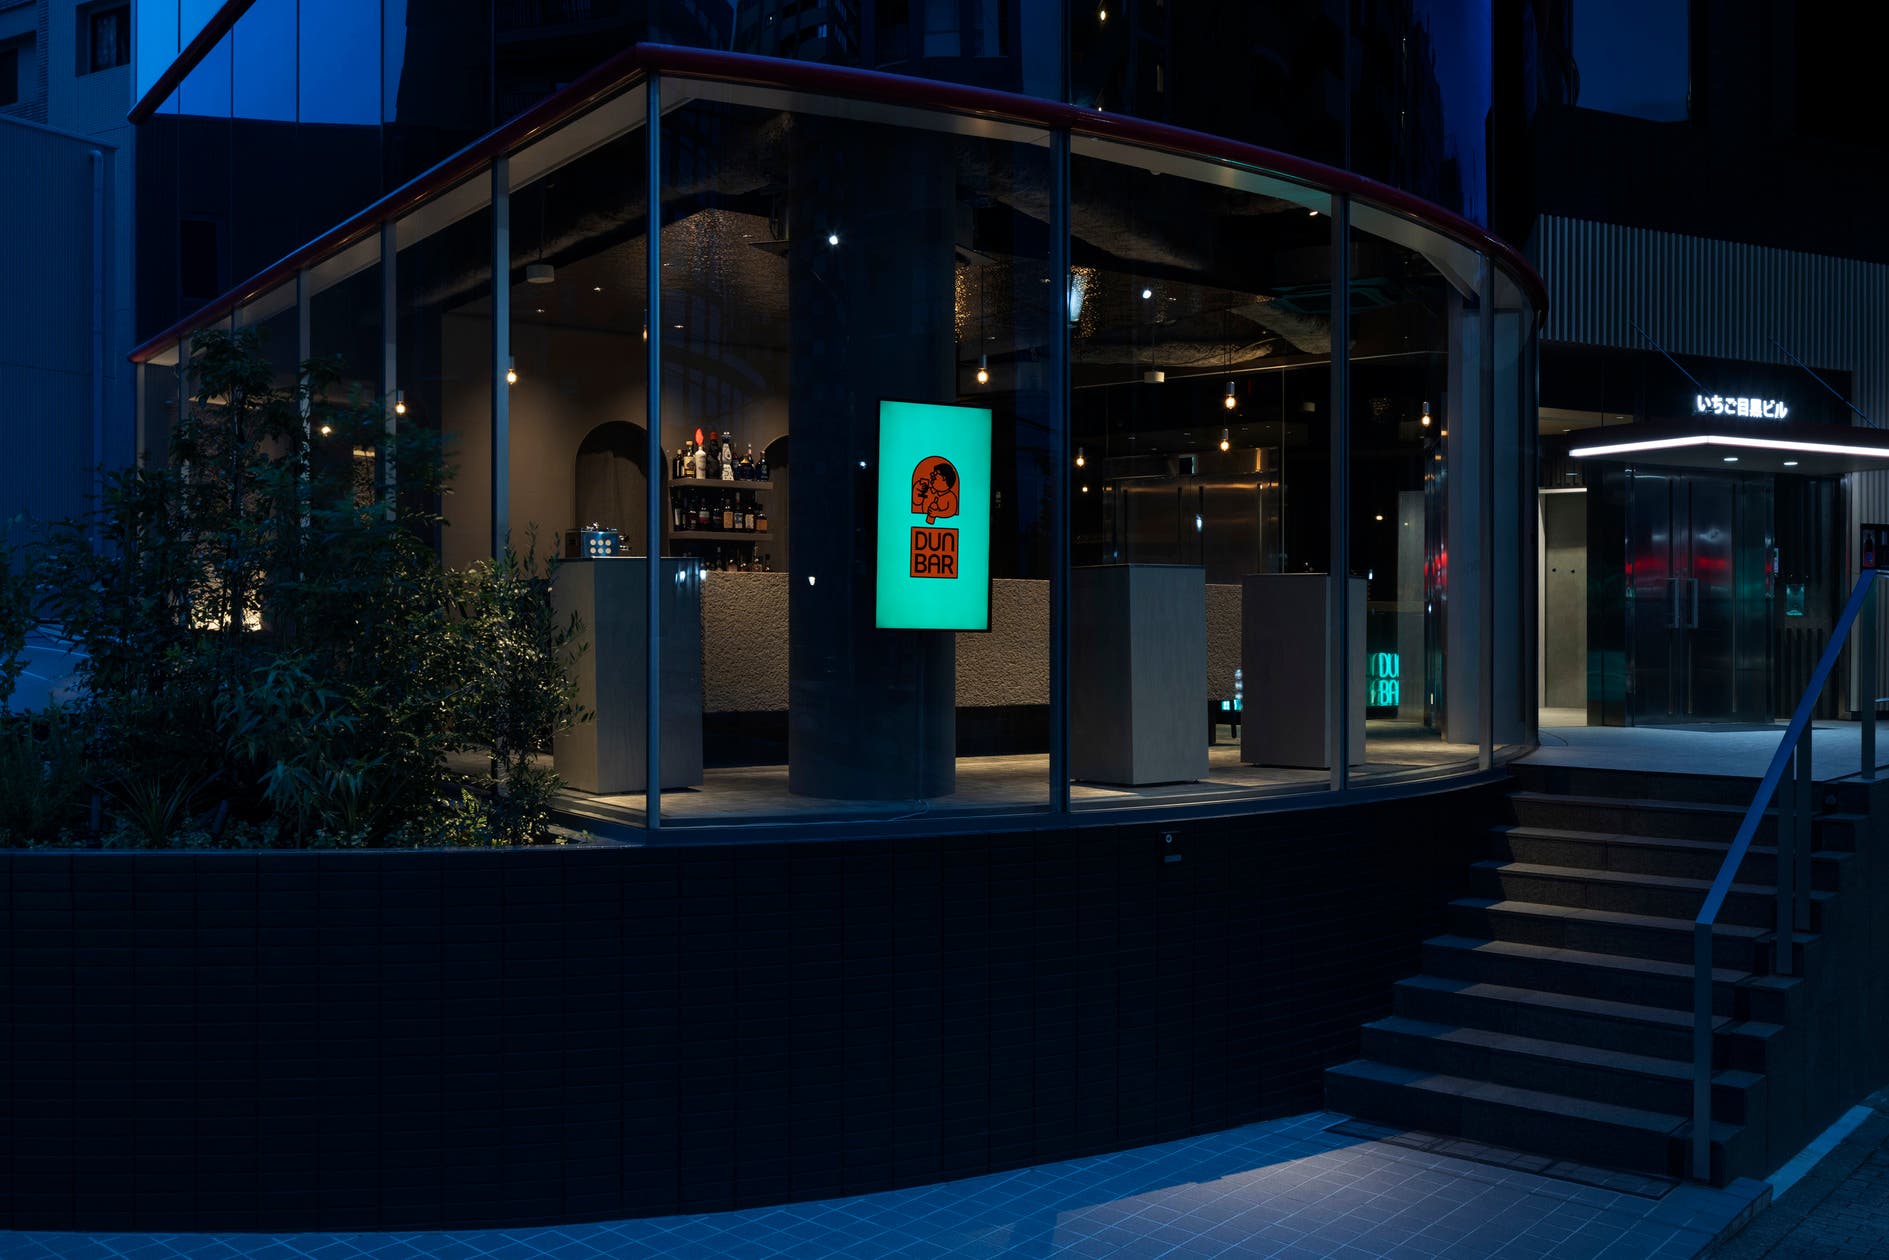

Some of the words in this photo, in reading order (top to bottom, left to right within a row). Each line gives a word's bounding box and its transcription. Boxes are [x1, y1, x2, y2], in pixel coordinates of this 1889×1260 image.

[1697, 394, 1788, 419] いちご目黒ビル
[914, 553, 954, 574] BAR
[1379, 652, 1400, 678] DU
[1379, 679, 1400, 706] BA
